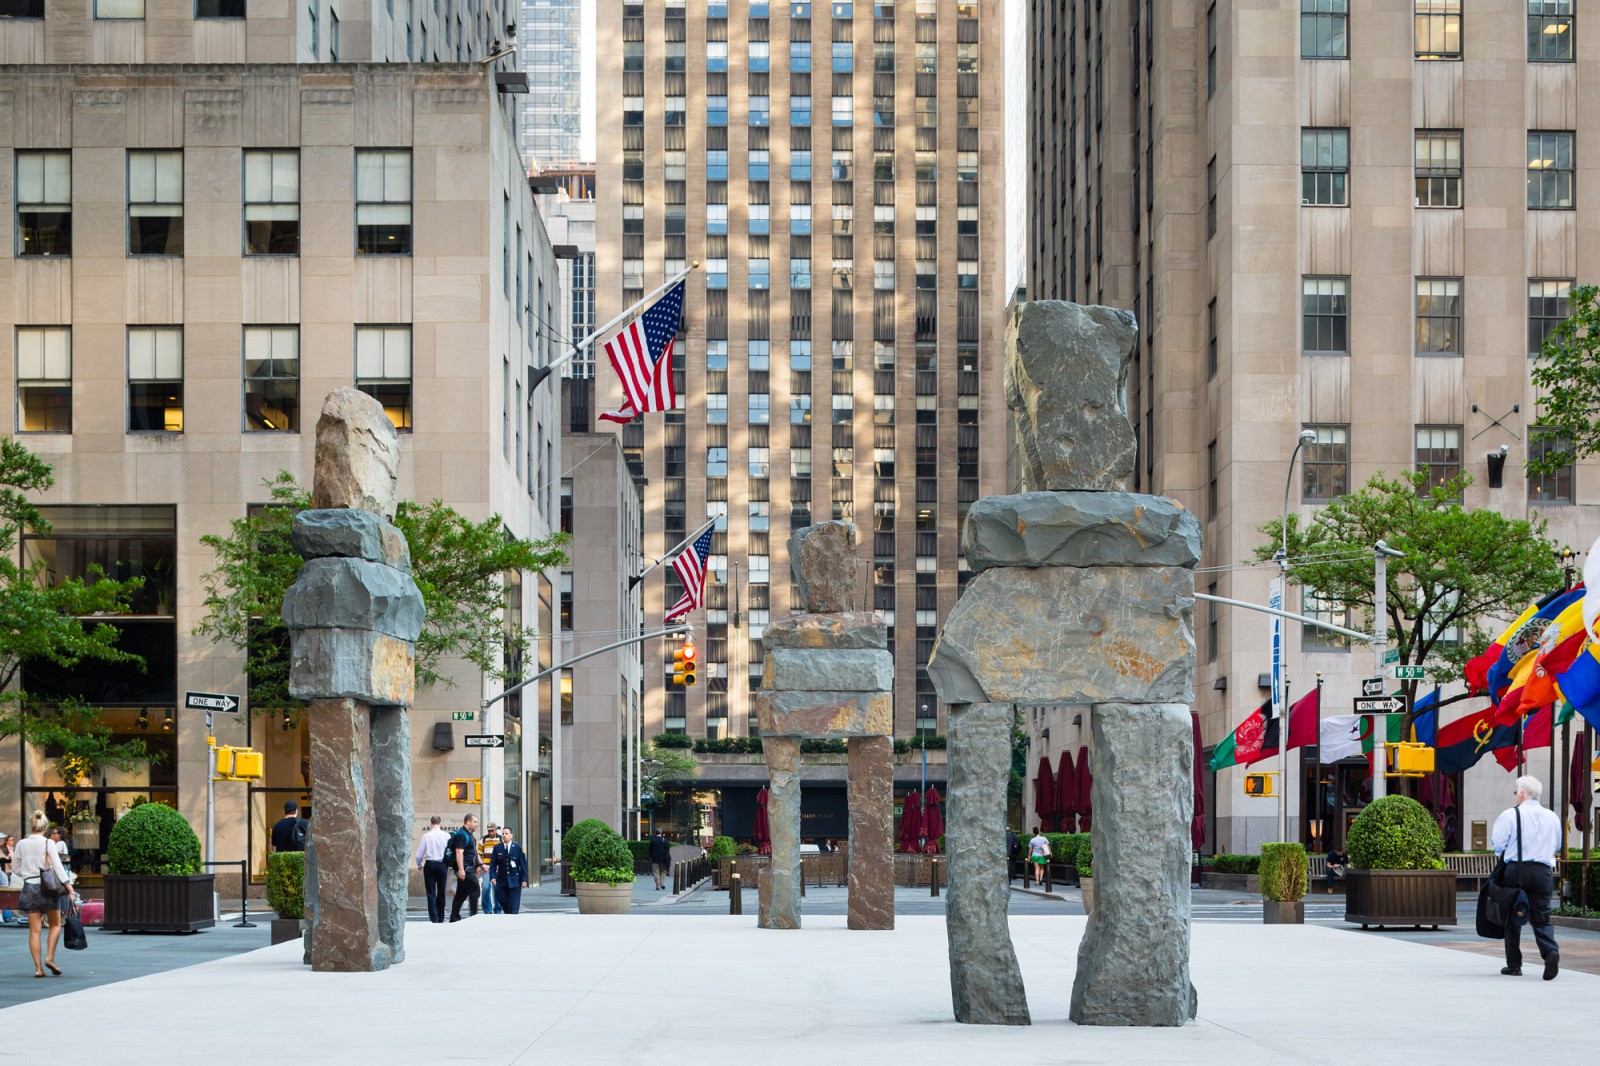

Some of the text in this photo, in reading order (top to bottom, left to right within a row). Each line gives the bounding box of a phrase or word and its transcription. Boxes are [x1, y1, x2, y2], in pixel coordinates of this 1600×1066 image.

[1397, 667, 1403, 677] W
[1405, 667, 1414, 677] 50
[192, 697, 231, 708] ONE WAY
[1360, 701, 1398, 709] ONE WAY
[460, 712, 467, 720] 50
